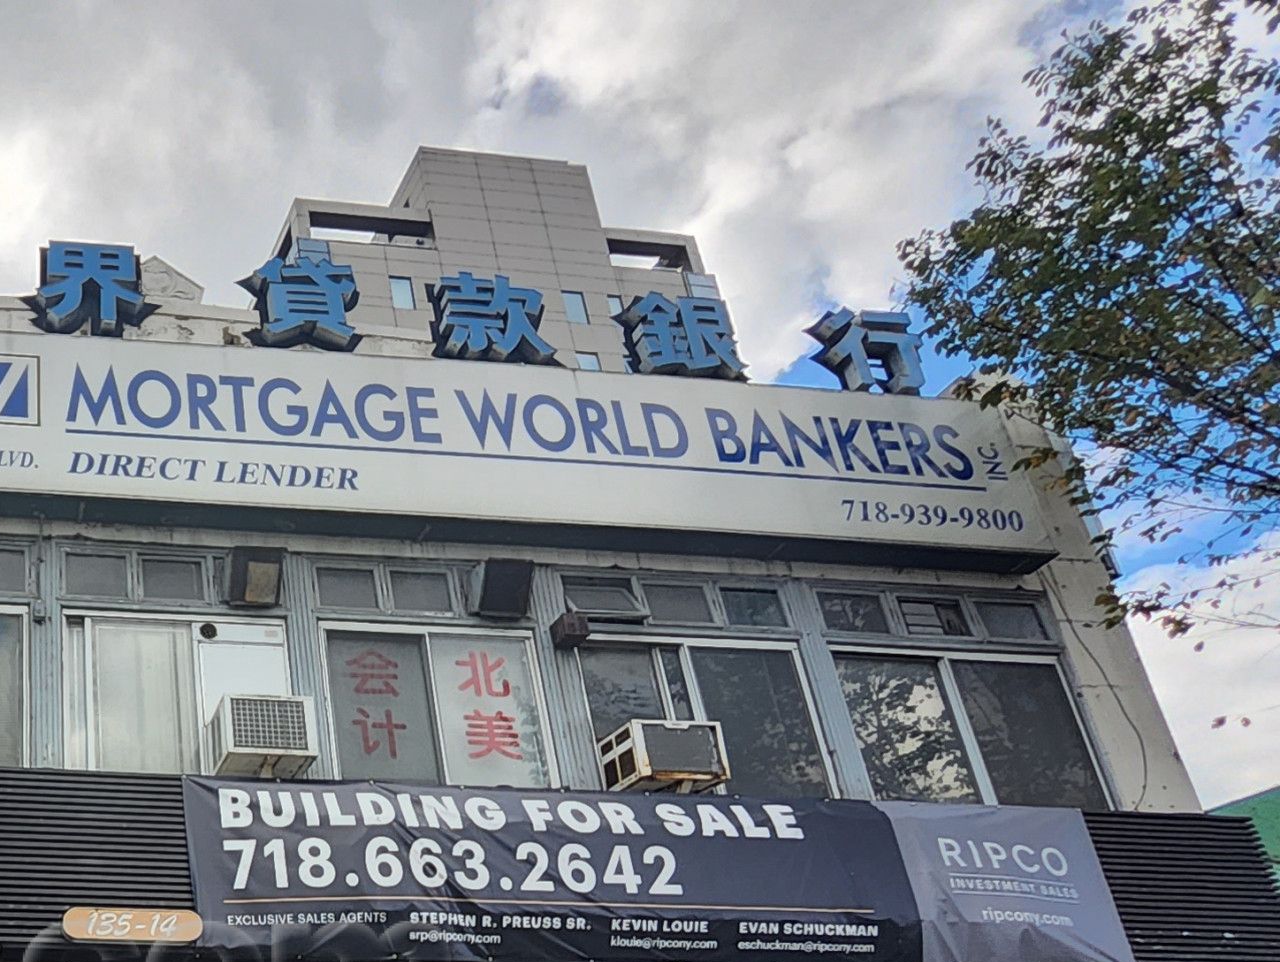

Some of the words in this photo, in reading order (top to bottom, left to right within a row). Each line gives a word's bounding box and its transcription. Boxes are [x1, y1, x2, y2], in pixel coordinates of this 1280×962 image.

[65, 362, 442, 445] MORTGAGE
[455, 388, 689, 459] WORLD
[703, 407, 974, 481] BANKERS
[976, 442, 1009, 481] INC.
[66, 451, 206, 484] DIRECT
[212, 459, 360, 492] LENDER
[842, 498, 1024, 533] 718-939-9800
[218, 788, 507, 831] BUILDING
[521, 799, 645, 835] FOR
[655, 803, 806, 840] SALE
[222, 837, 684, 893] 718.663.2642
[937, 837, 1068, 877] RIPCO
[949, 877, 1036, 894] INVESTMENT
[1040, 884, 1079, 899] SALES
[86, 910, 178, 937] 135-14
[227, 914, 294, 926] EXCLUSIVE
[297, 913, 336, 925] SALES
[339, 911, 388, 924] AGENTS
[409, 912, 477, 928] STEPHEN
[481, 914, 498, 928] R.
[502, 916, 562, 930] PREUSS
[566, 917, 592, 931] SR.
[611, 919, 658, 932] KEVIN
[662, 921, 709, 933] LOUIE
[981, 906, 1074, 927] ripcony.com
[738, 922, 779, 935] EVAN
[782, 923, 878, 937] SCHUCKMAN
[610, 935, 718, 951] klouie@ripcony.com
